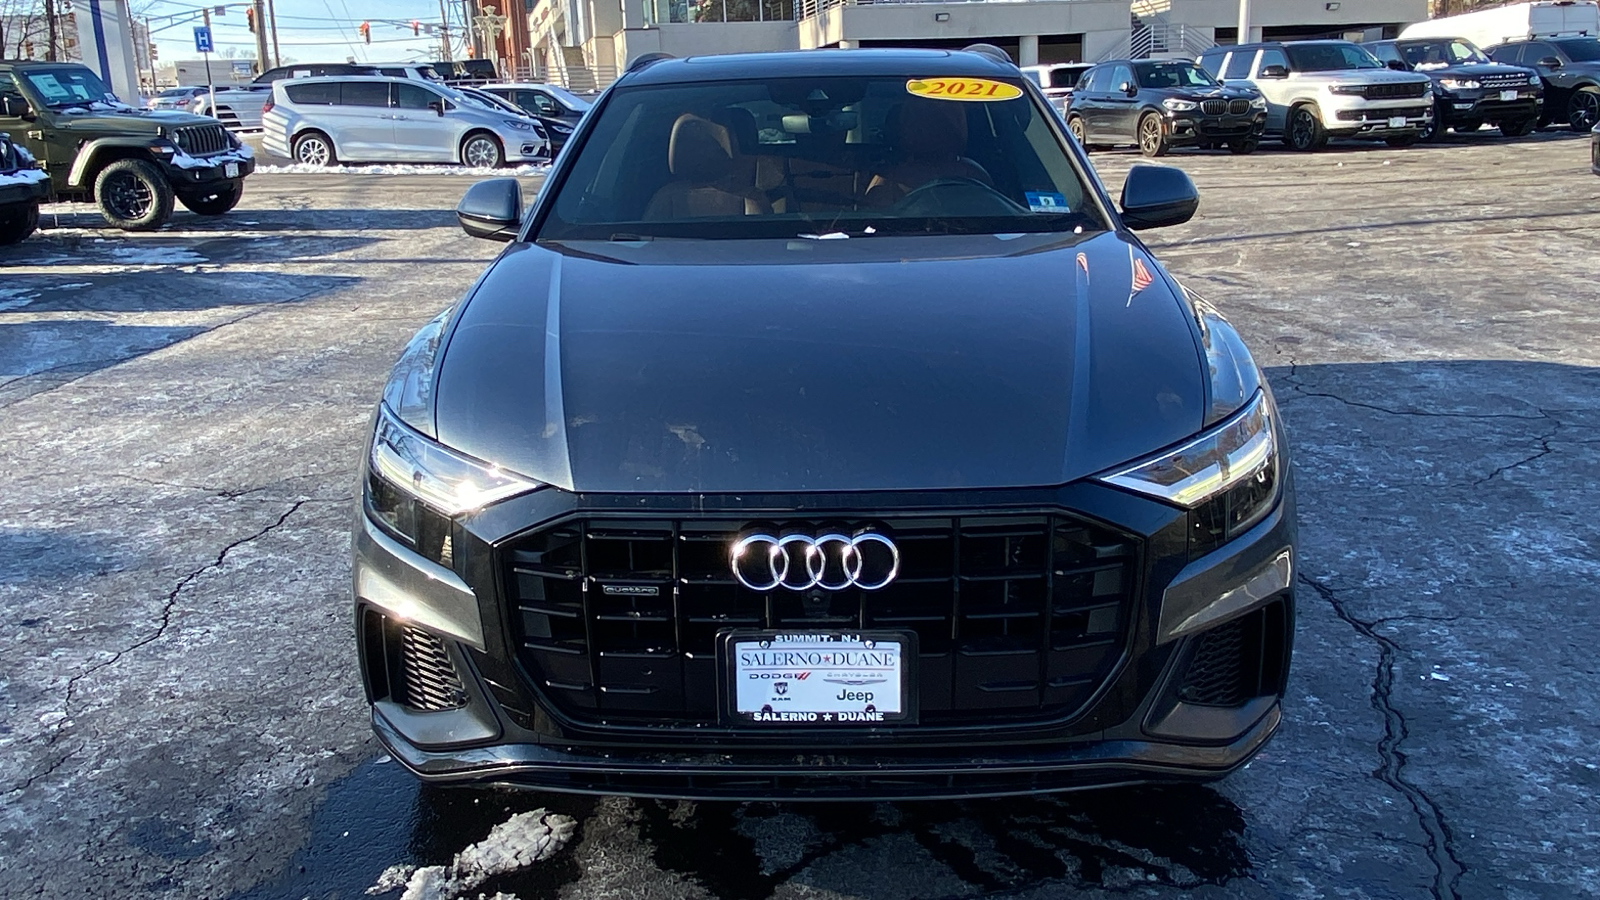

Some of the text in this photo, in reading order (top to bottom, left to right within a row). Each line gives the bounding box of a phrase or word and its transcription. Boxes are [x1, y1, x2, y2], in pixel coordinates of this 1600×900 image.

[198, 32, 209, 45] H
[927, 82, 999, 96] 2021
[775, 634, 861, 643] SUMMIT, NJ
[741, 652, 895, 666] SALERNO DUANE
[836, 688, 874, 703] Jeep
[753, 712, 884, 721] SALERNO DUANE
